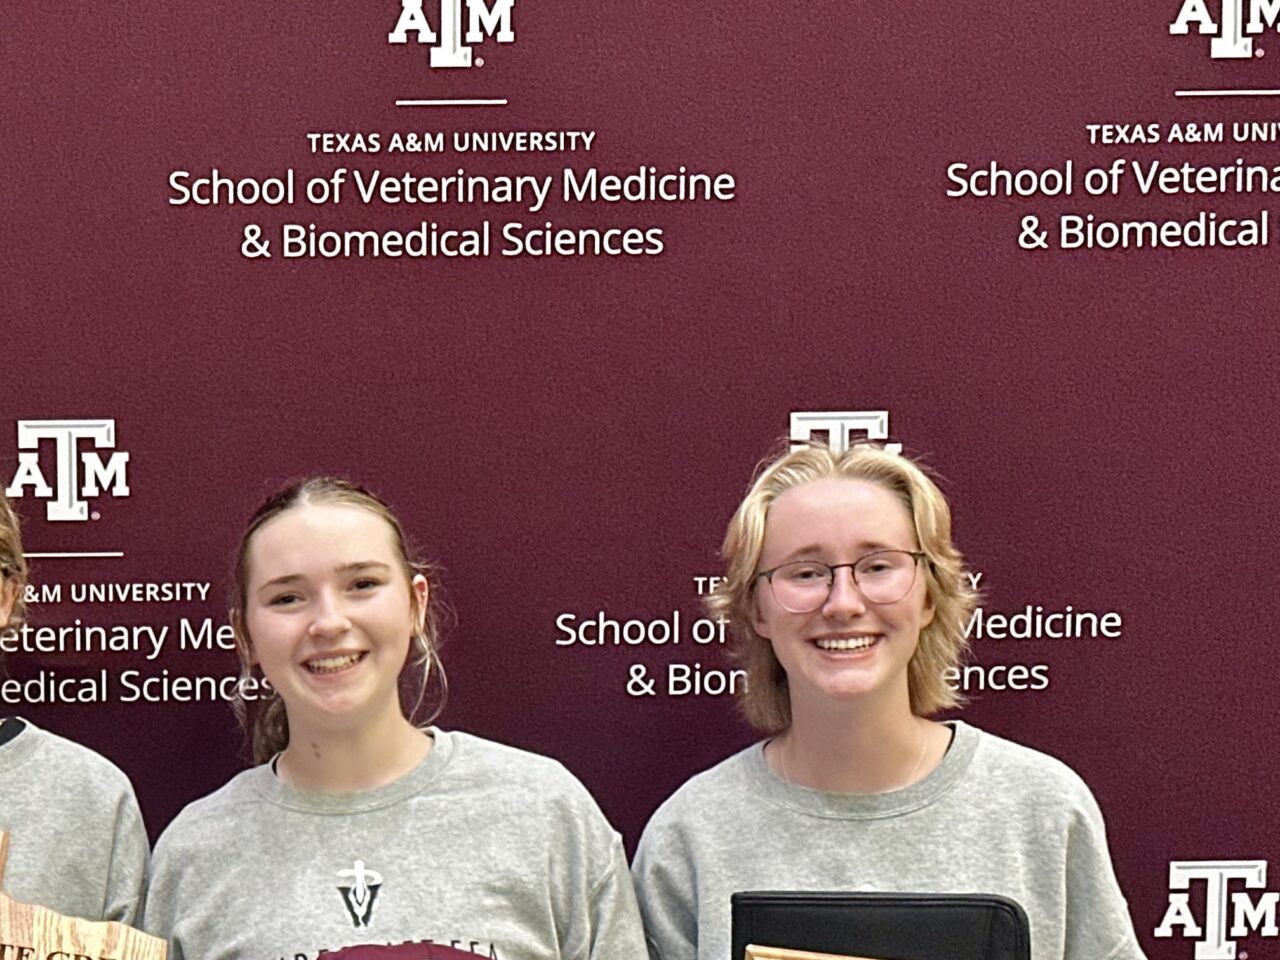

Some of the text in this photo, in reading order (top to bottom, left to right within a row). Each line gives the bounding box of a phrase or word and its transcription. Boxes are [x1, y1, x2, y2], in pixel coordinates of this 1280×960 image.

[306, 130, 596, 153] TEXAS A&M UNIVERSITY
[1085, 124, 1160, 145] TEXAS
[1167, 122, 1224, 143] A&M
[168, 165, 736, 212] School of Veterinary Medicine
[946, 160, 1073, 197] School
[1084, 159, 1126, 195] of
[241, 220, 664, 258] & Biomedical Sciences
[1018, 210, 1268, 249] & Biomedical
[71, 581, 211, 602] UNIVERSITY
[555, 610, 680, 646] School
[691, 612, 731, 644] of
[625, 663, 657, 696] &
